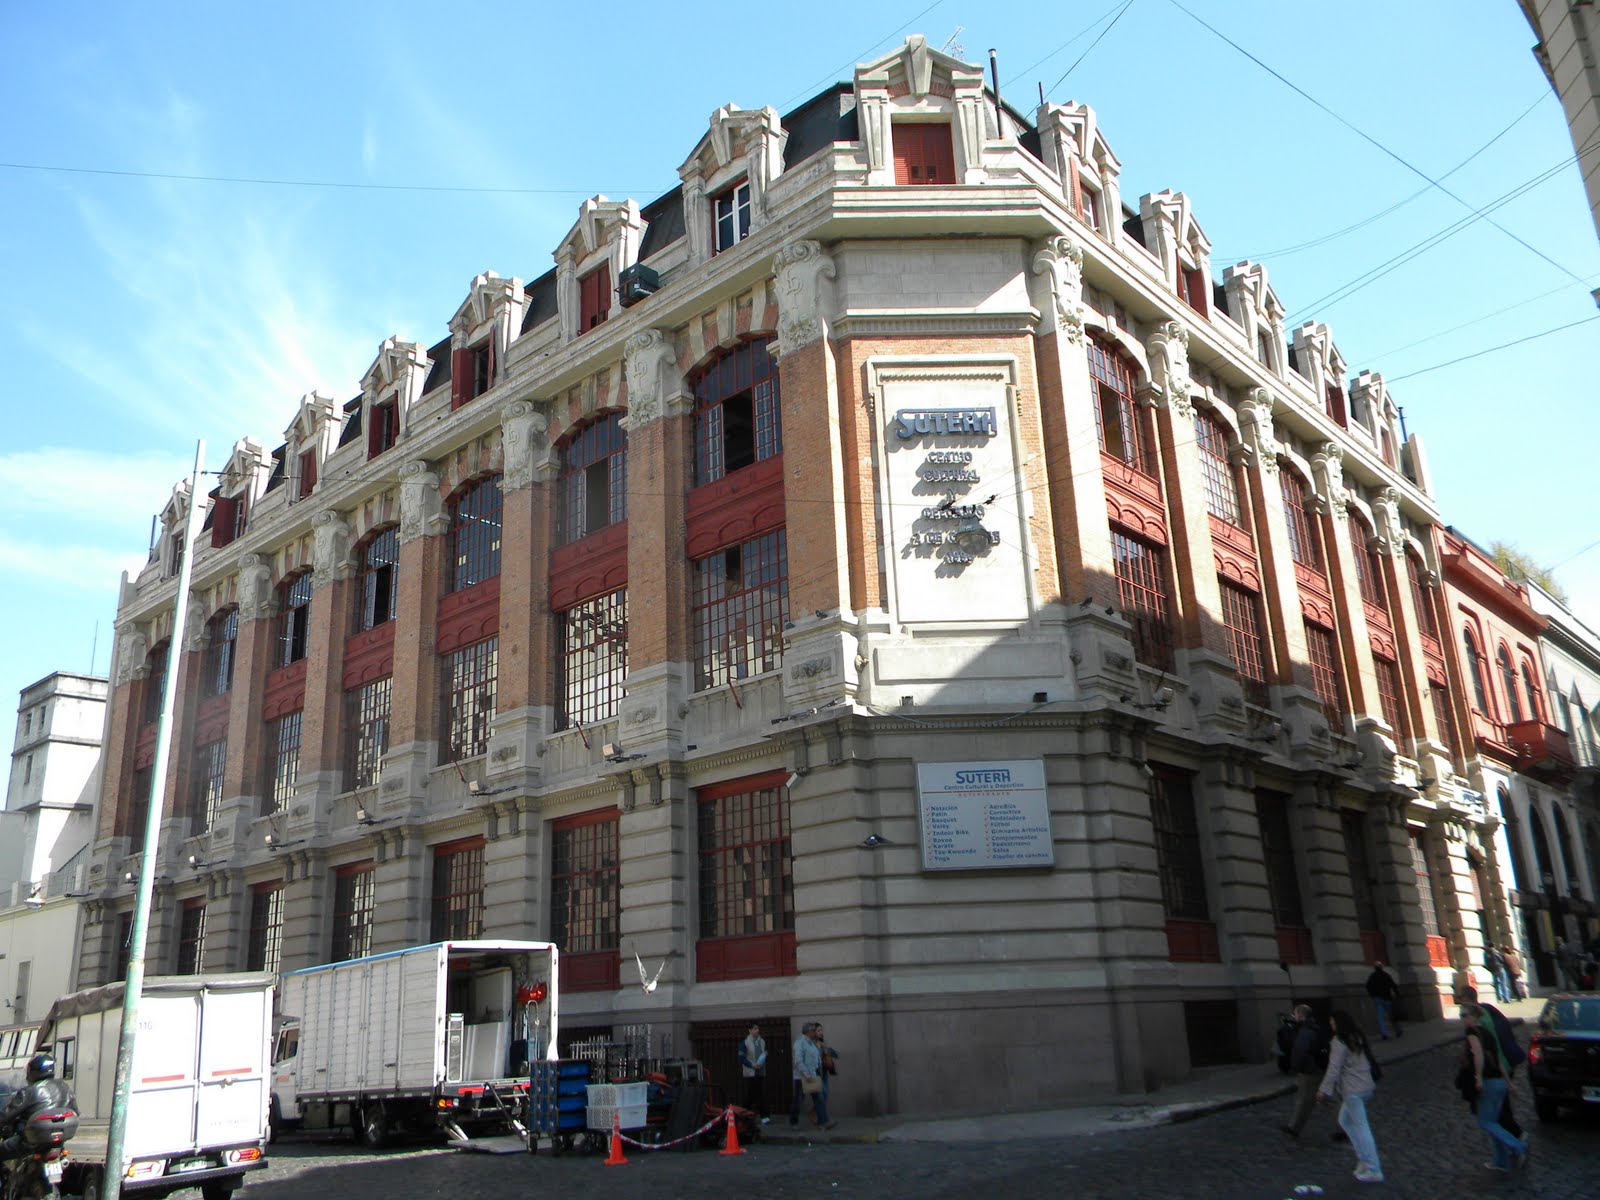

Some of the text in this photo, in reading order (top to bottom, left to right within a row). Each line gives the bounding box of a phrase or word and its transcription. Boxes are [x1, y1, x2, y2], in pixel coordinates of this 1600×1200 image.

[895, 406, 997, 438] SUTERH
[926, 451, 973, 465] CENTRO
[923, 469, 980, 483] CULTURAL
[921, 505, 985, 520] DEPOTVO
[926, 532, 943, 546] DE
[955, 769, 1011, 784] SUTERH
